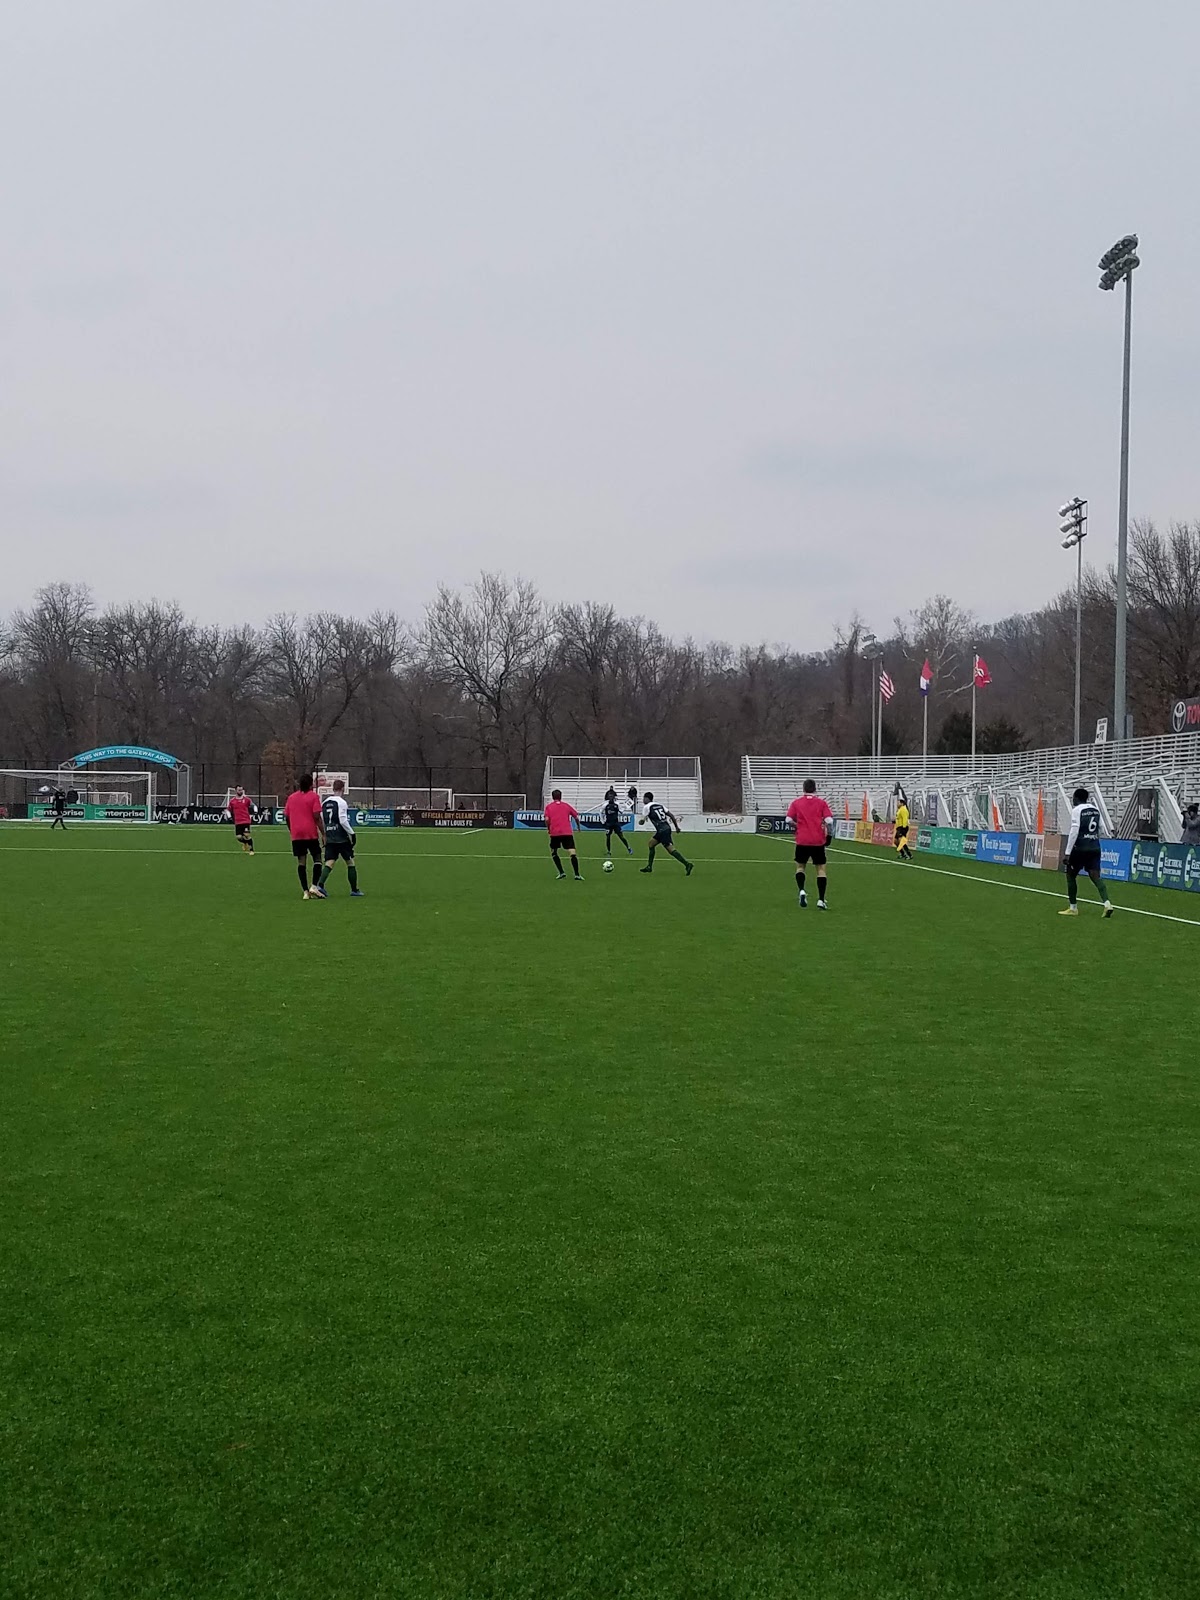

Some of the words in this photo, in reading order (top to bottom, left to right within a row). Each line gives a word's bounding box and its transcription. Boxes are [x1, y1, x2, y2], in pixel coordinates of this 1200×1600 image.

[80, 754, 93, 762] THIS
[127, 749, 155, 758] GATEWAY
[155, 754, 171, 763] ARCH
[34, 809, 84, 818] enteprise
[95, 809, 145, 819] enterprise
[153, 810, 182, 821] Mercy
[193, 811, 223, 823] Mercy
[249, 814, 263, 824] rcy
[326, 808, 334, 824] 7
[516, 813, 545, 821] MATTRES
[655, 808, 666, 821] 15
[1088, 816, 1097, 833] 6
